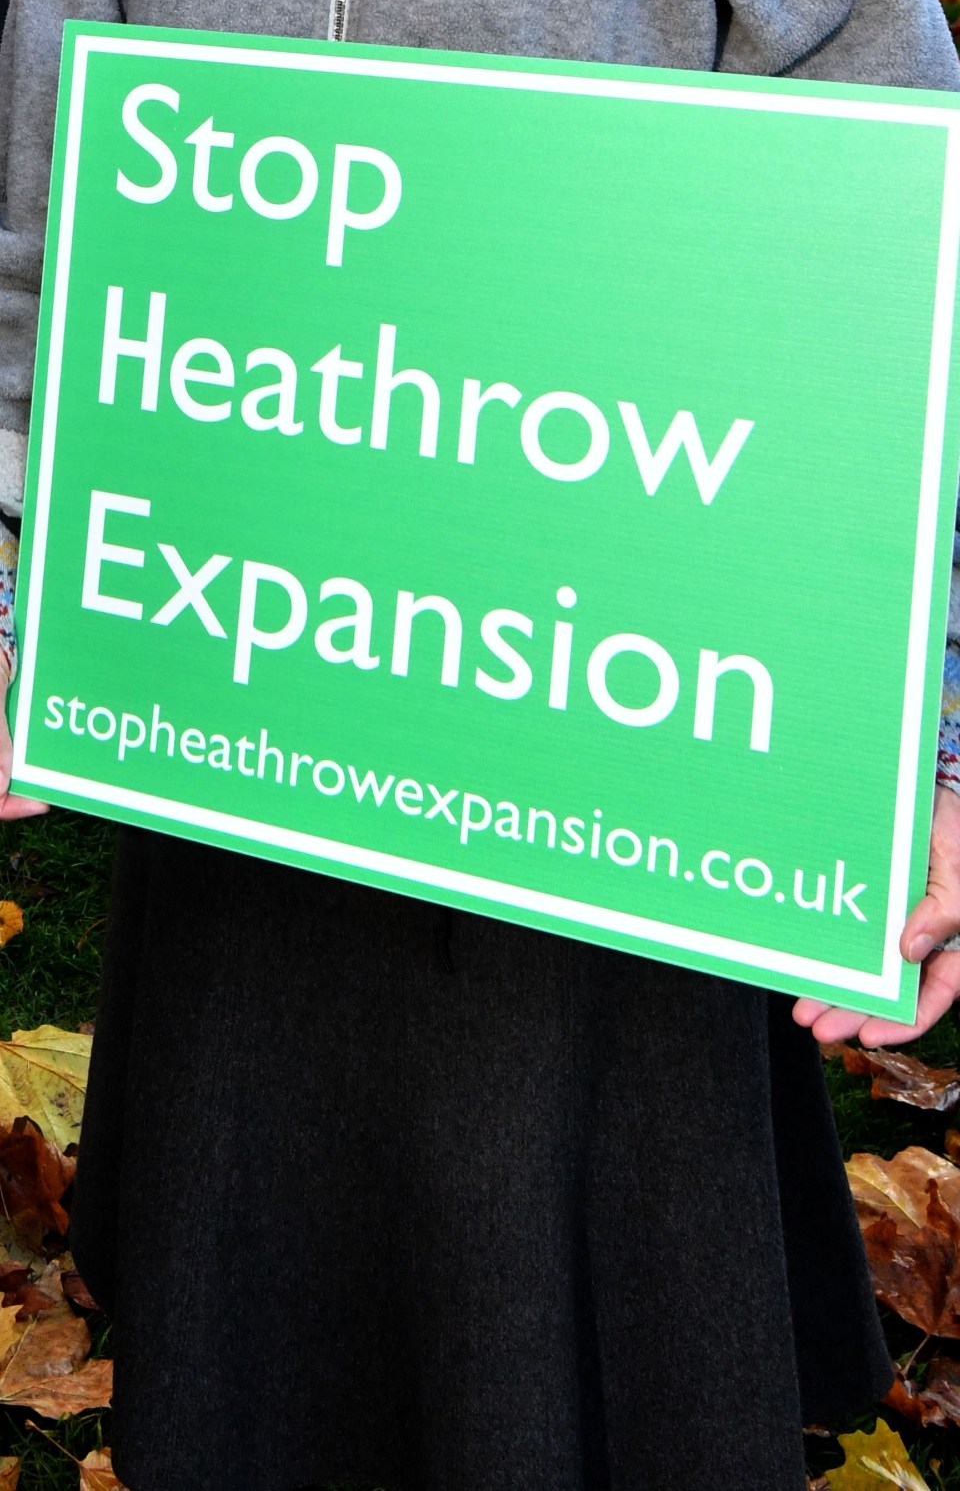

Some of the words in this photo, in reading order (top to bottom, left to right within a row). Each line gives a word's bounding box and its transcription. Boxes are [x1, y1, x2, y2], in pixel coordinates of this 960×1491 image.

[115, 82, 403, 268] Stop
[97, 284, 756, 506] Heathrow
[80, 489, 775, 753] Expansion
[43, 694, 869, 924] stopheathrowexpansion.co.uk
